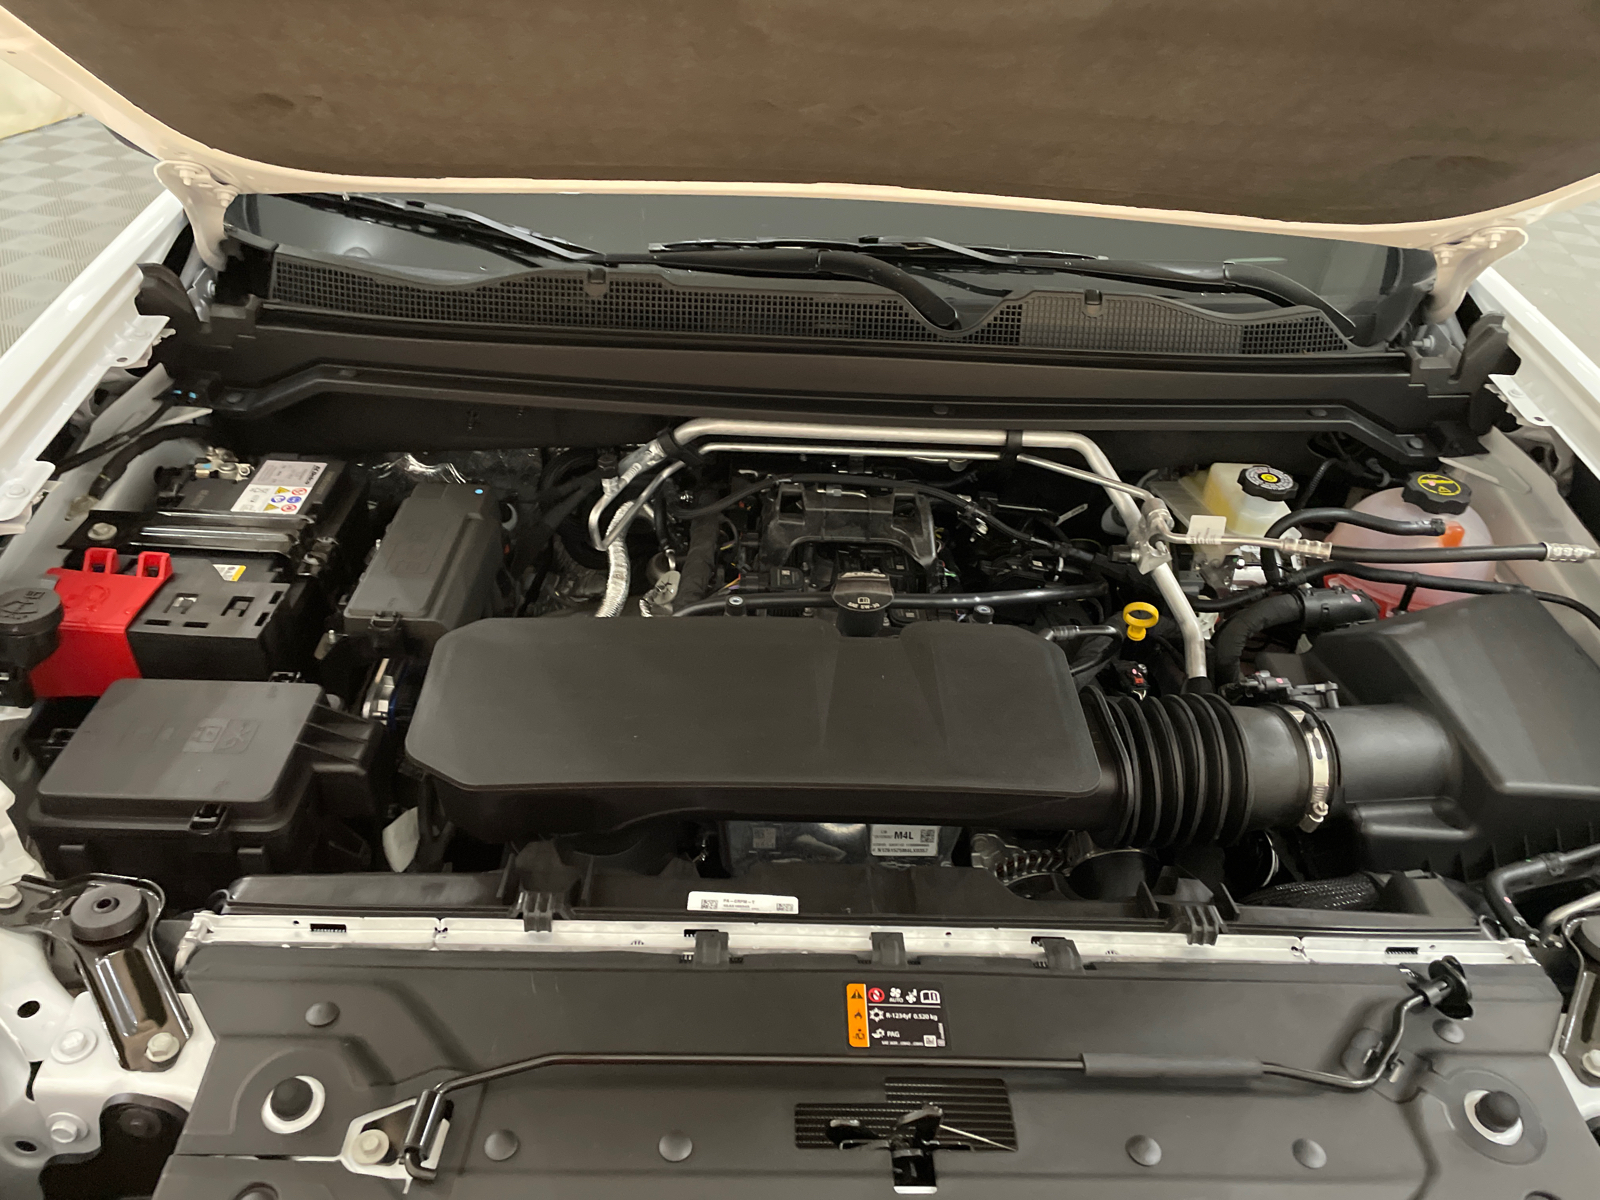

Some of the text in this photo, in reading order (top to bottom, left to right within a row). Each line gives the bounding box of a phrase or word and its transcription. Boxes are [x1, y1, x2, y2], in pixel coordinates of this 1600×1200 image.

[894, 831, 914, 840] M4L
[885, 1012, 939, 1021] R-1234yf 0.520 kg
